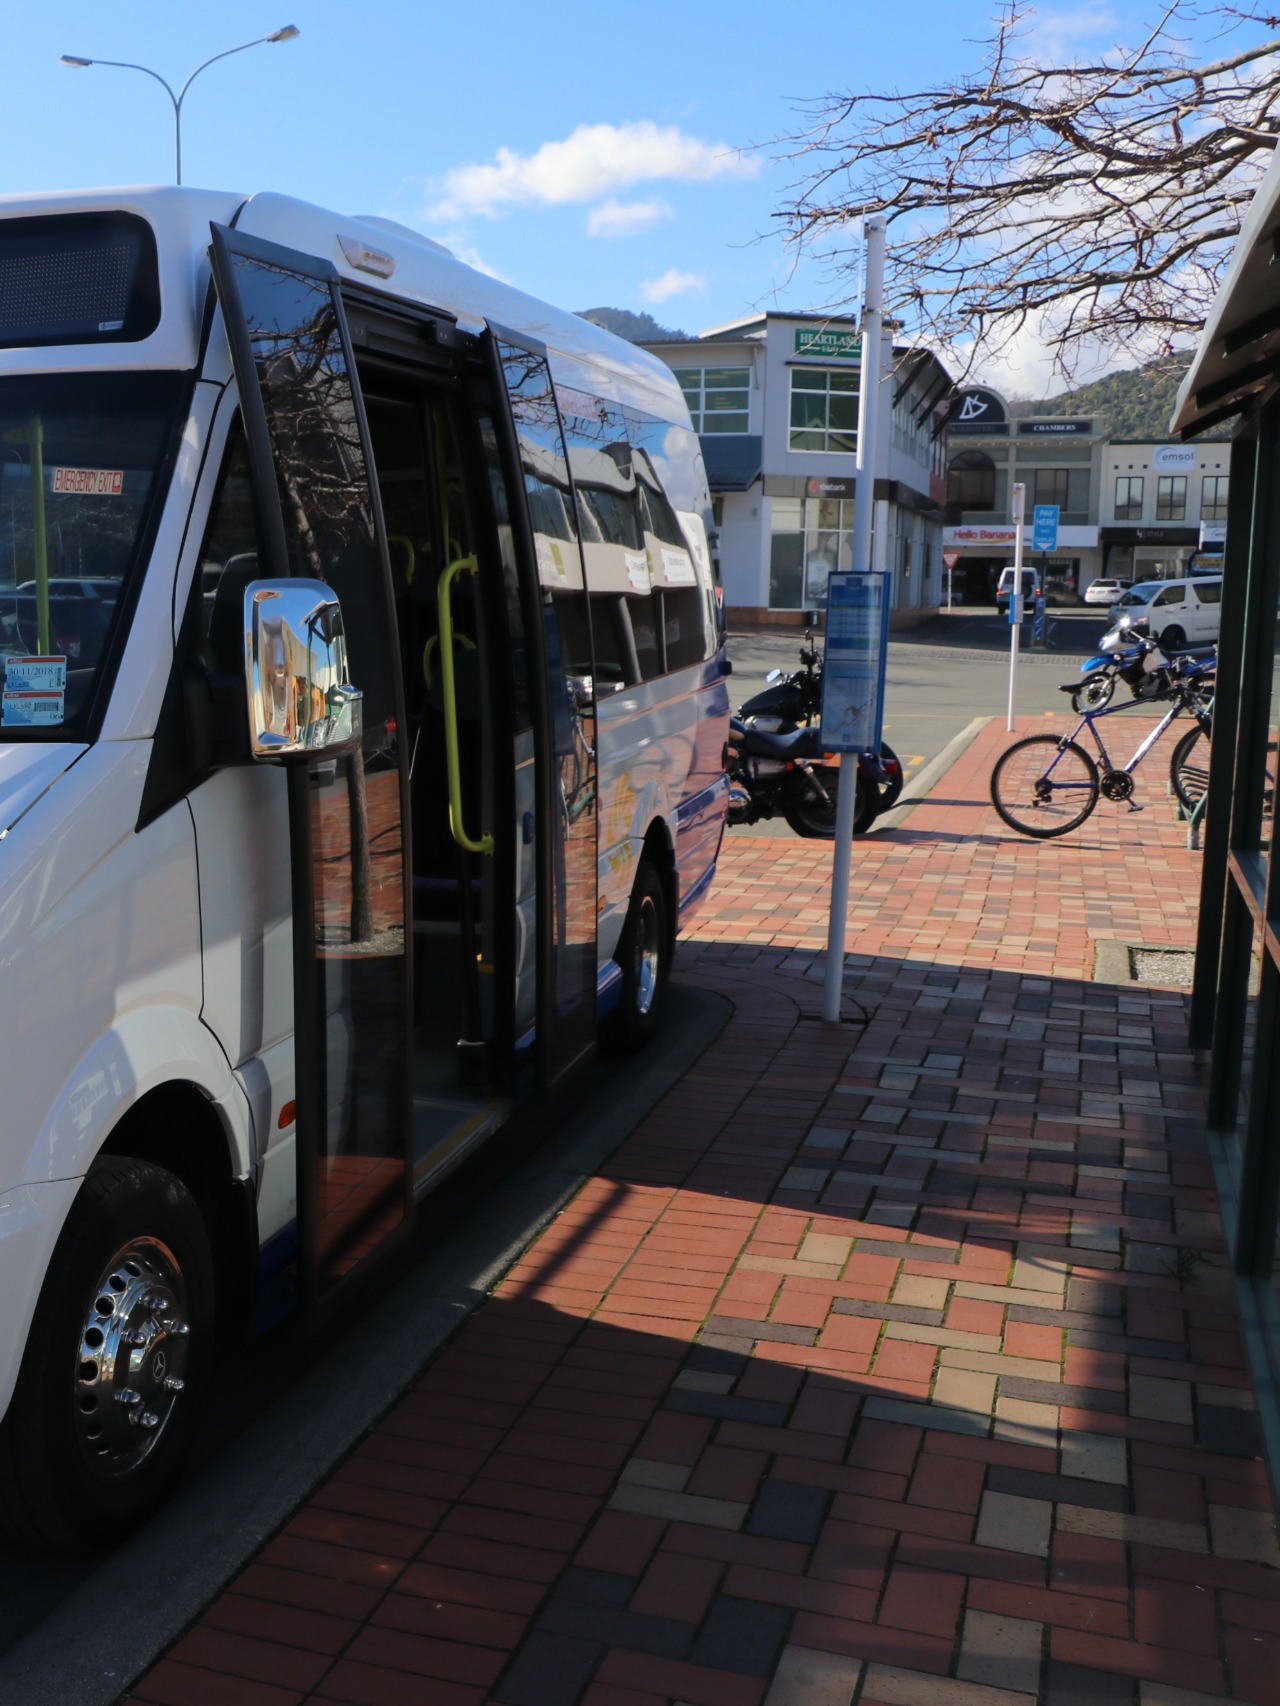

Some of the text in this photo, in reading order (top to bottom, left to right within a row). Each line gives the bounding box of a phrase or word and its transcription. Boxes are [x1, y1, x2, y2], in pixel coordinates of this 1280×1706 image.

[800, 333, 861, 346] HEARTLAND
[1162, 452, 1194, 461] emsol
[55, 470, 114, 492] EMERGENCY EXIT
[953, 530, 1016, 539] Hello Banana
[8, 667, 54, 676] 30/11/2018
